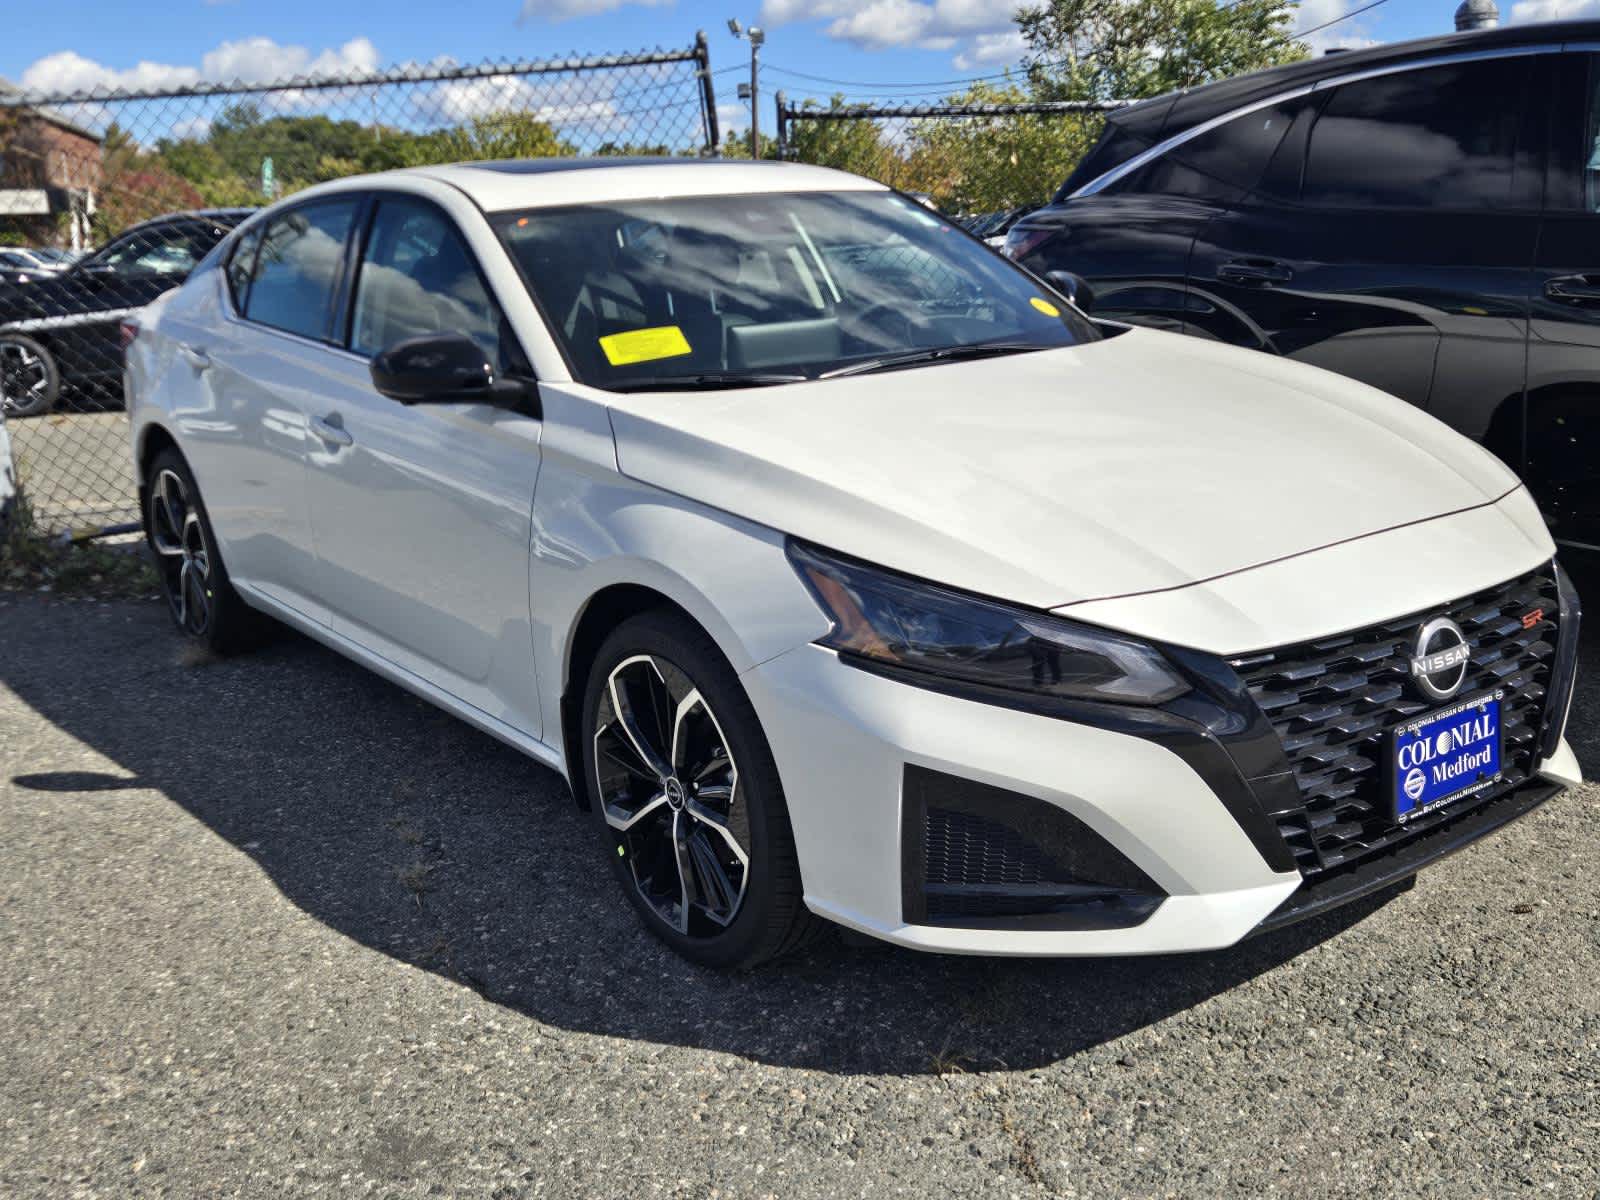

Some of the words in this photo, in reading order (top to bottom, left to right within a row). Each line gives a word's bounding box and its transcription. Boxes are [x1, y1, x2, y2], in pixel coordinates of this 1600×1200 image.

[1413, 644, 1471, 674] NISSAN
[1436, 707, 1457, 721] NISSAN
[1457, 703, 1466, 713] OF
[1398, 714, 1495, 770] COLONIAL
[1432, 744, 1492, 785] Medford
